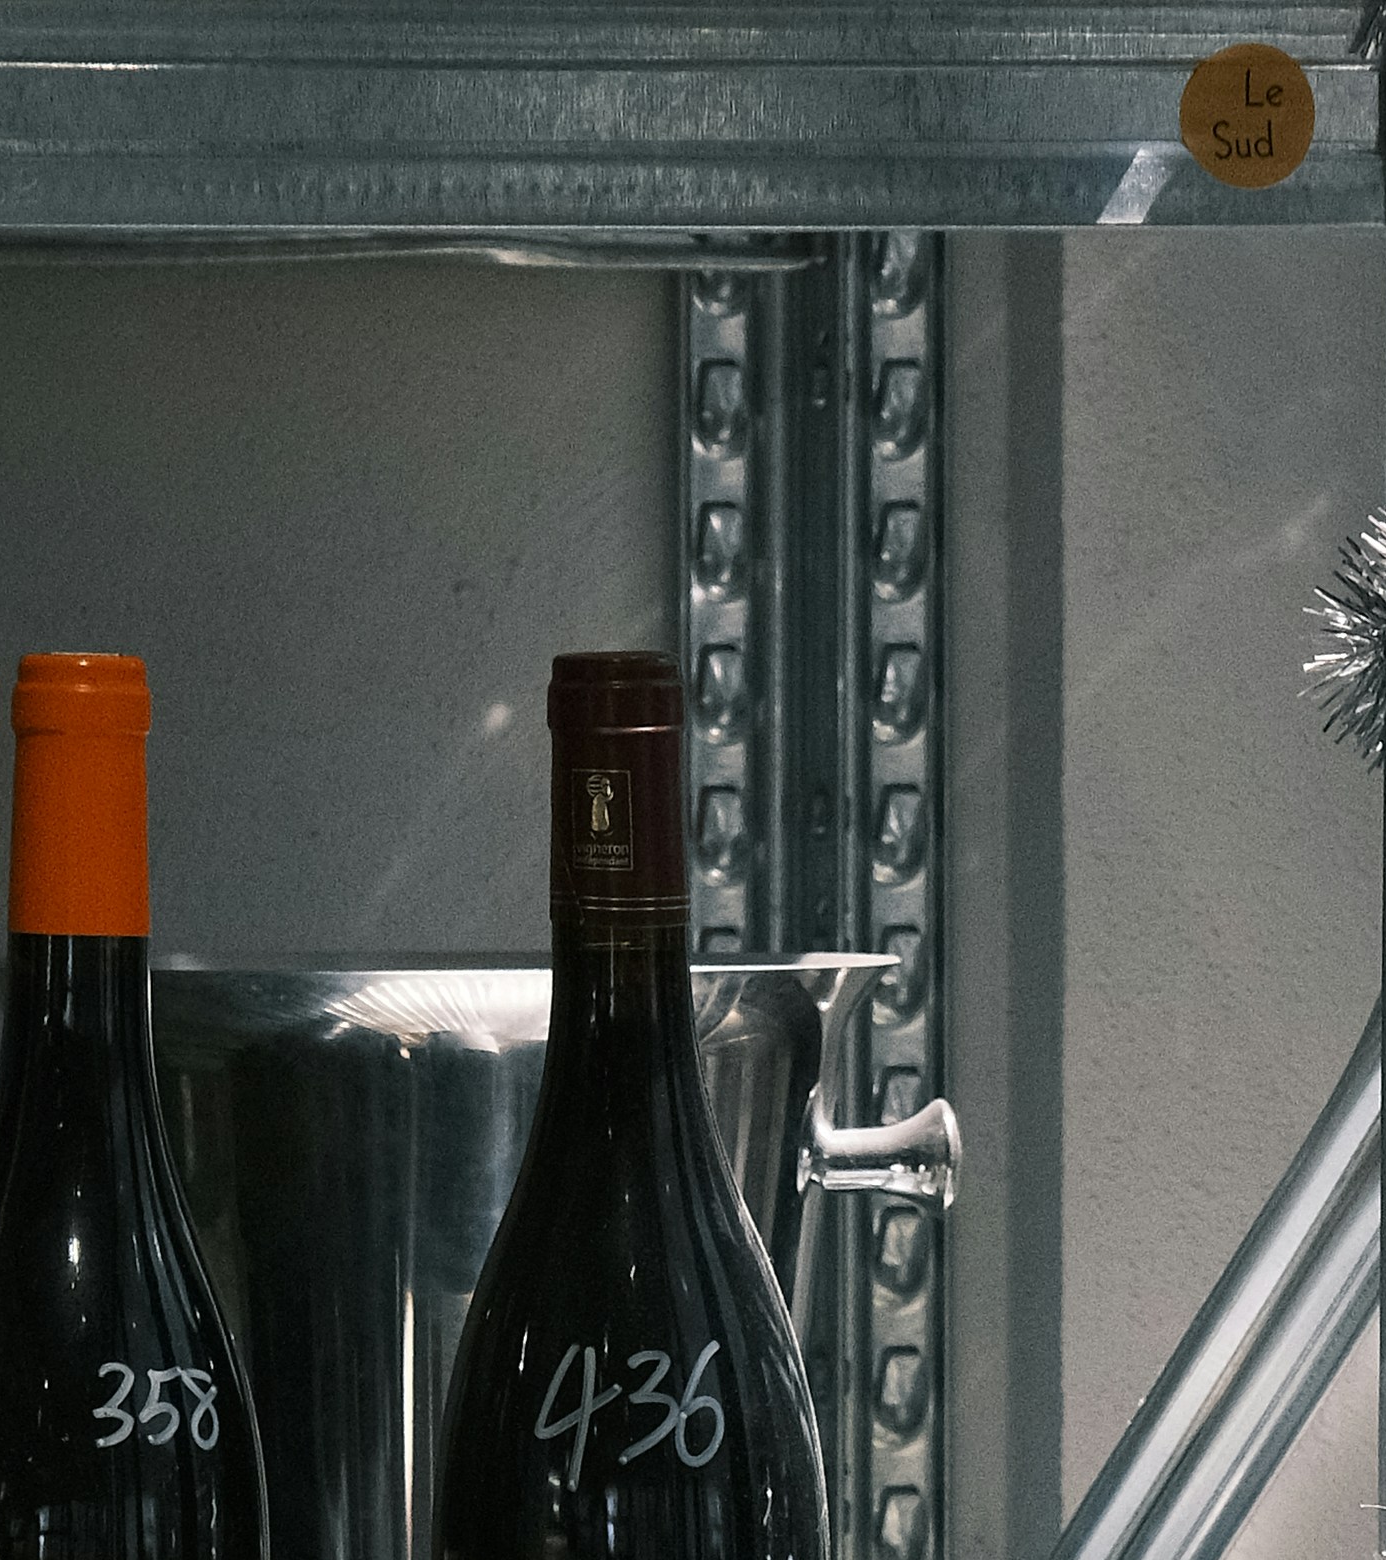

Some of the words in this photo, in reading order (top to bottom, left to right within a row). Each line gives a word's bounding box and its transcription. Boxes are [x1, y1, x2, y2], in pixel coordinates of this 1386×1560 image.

[1244, 67, 1284, 108] Le
[1212, 119, 1274, 160] Sud
[92, 1361, 220, 1450] 358
[533, 1339, 726, 1492] 436
